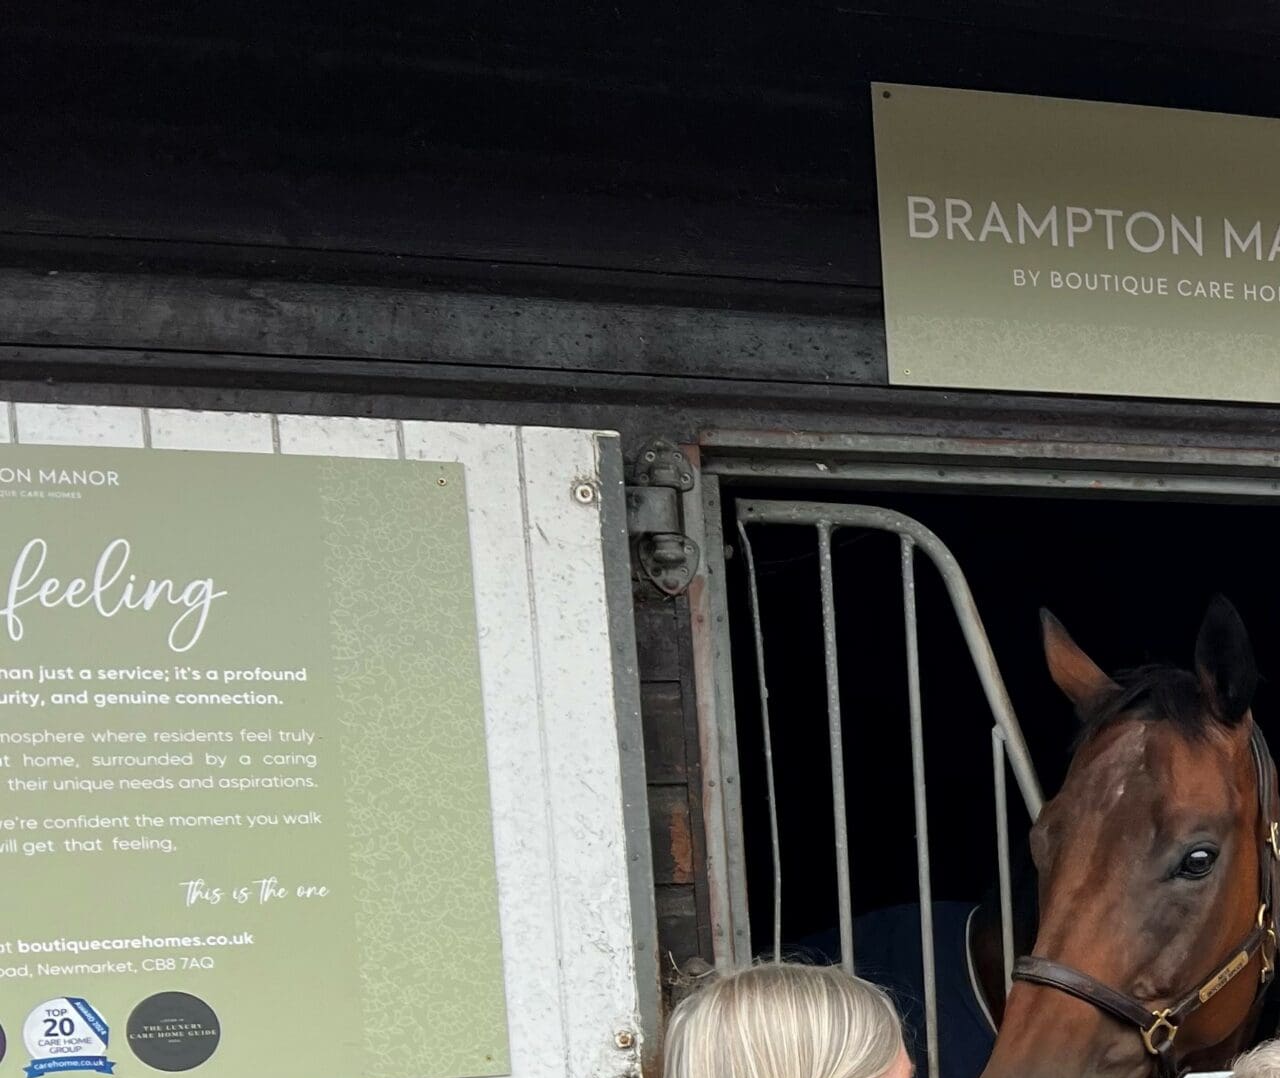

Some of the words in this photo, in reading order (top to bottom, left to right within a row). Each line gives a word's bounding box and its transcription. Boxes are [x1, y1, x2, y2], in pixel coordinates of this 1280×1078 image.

[907, 195, 1203, 256] BRAMPTON
[1013, 269, 1040, 287] BY
[1050, 271, 1168, 296] BOUTIQUE
[1177, 279, 1234, 299] CARE
[39, 469, 119, 486] MANOR
[0, 538, 228, 652] feeling
[38, 665, 74, 683] just
[79, 669, 92, 680] a
[98, 666, 169, 682] service;
[174, 666, 201, 681] it's
[206, 669, 219, 681] a
[223, 667, 307, 684] profound
[51, 690, 88, 704] and
[94, 690, 170, 708] genuine
[175, 691, 284, 705] connection.
[92, 730, 147, 743] where
[153, 729, 234, 742] residents
[240, 729, 272, 742] feel
[279, 729, 315, 745] truly
[23, 753, 80, 768] home,
[92, 752, 193, 767] surrounded
[205, 752, 227, 768] by
[239, 755, 251, 765] a
[263, 753, 317, 768] caring
[8, 778, 48, 791] their
[53, 777, 114, 793] unique
[119, 777, 174, 790] needs
[179, 775, 214, 789] and
[219, 774, 318, 790] aspirations.
[0, 816, 38, 830] e're
[43, 815, 130, 829] confident
[135, 814, 164, 827] the
[169, 813, 243, 826] moment
[247, 814, 279, 828] you
[283, 811, 322, 825] walk
[23, 840, 54, 856] get
[64, 838, 102, 851] that
[113, 836, 177, 852] feeling,
[232, 886, 252, 904] is
[296, 885, 329, 898] one
[17, 931, 254, 954] boutiquecarehomes.co.uk
[37, 960, 138, 977] Newmarket,
[141, 957, 176, 971] CB8
[180, 956, 214, 969] 7AQ
[45, 1009, 67, 1017] TOP
[43, 1017, 75, 1037] 20
[38, 1039, 61, 1047] CARE
[63, 1037, 92, 1045] HOME
[49, 1046, 82, 1054] GROUP
[33, 1058, 104, 1070] carehome.co.uk
